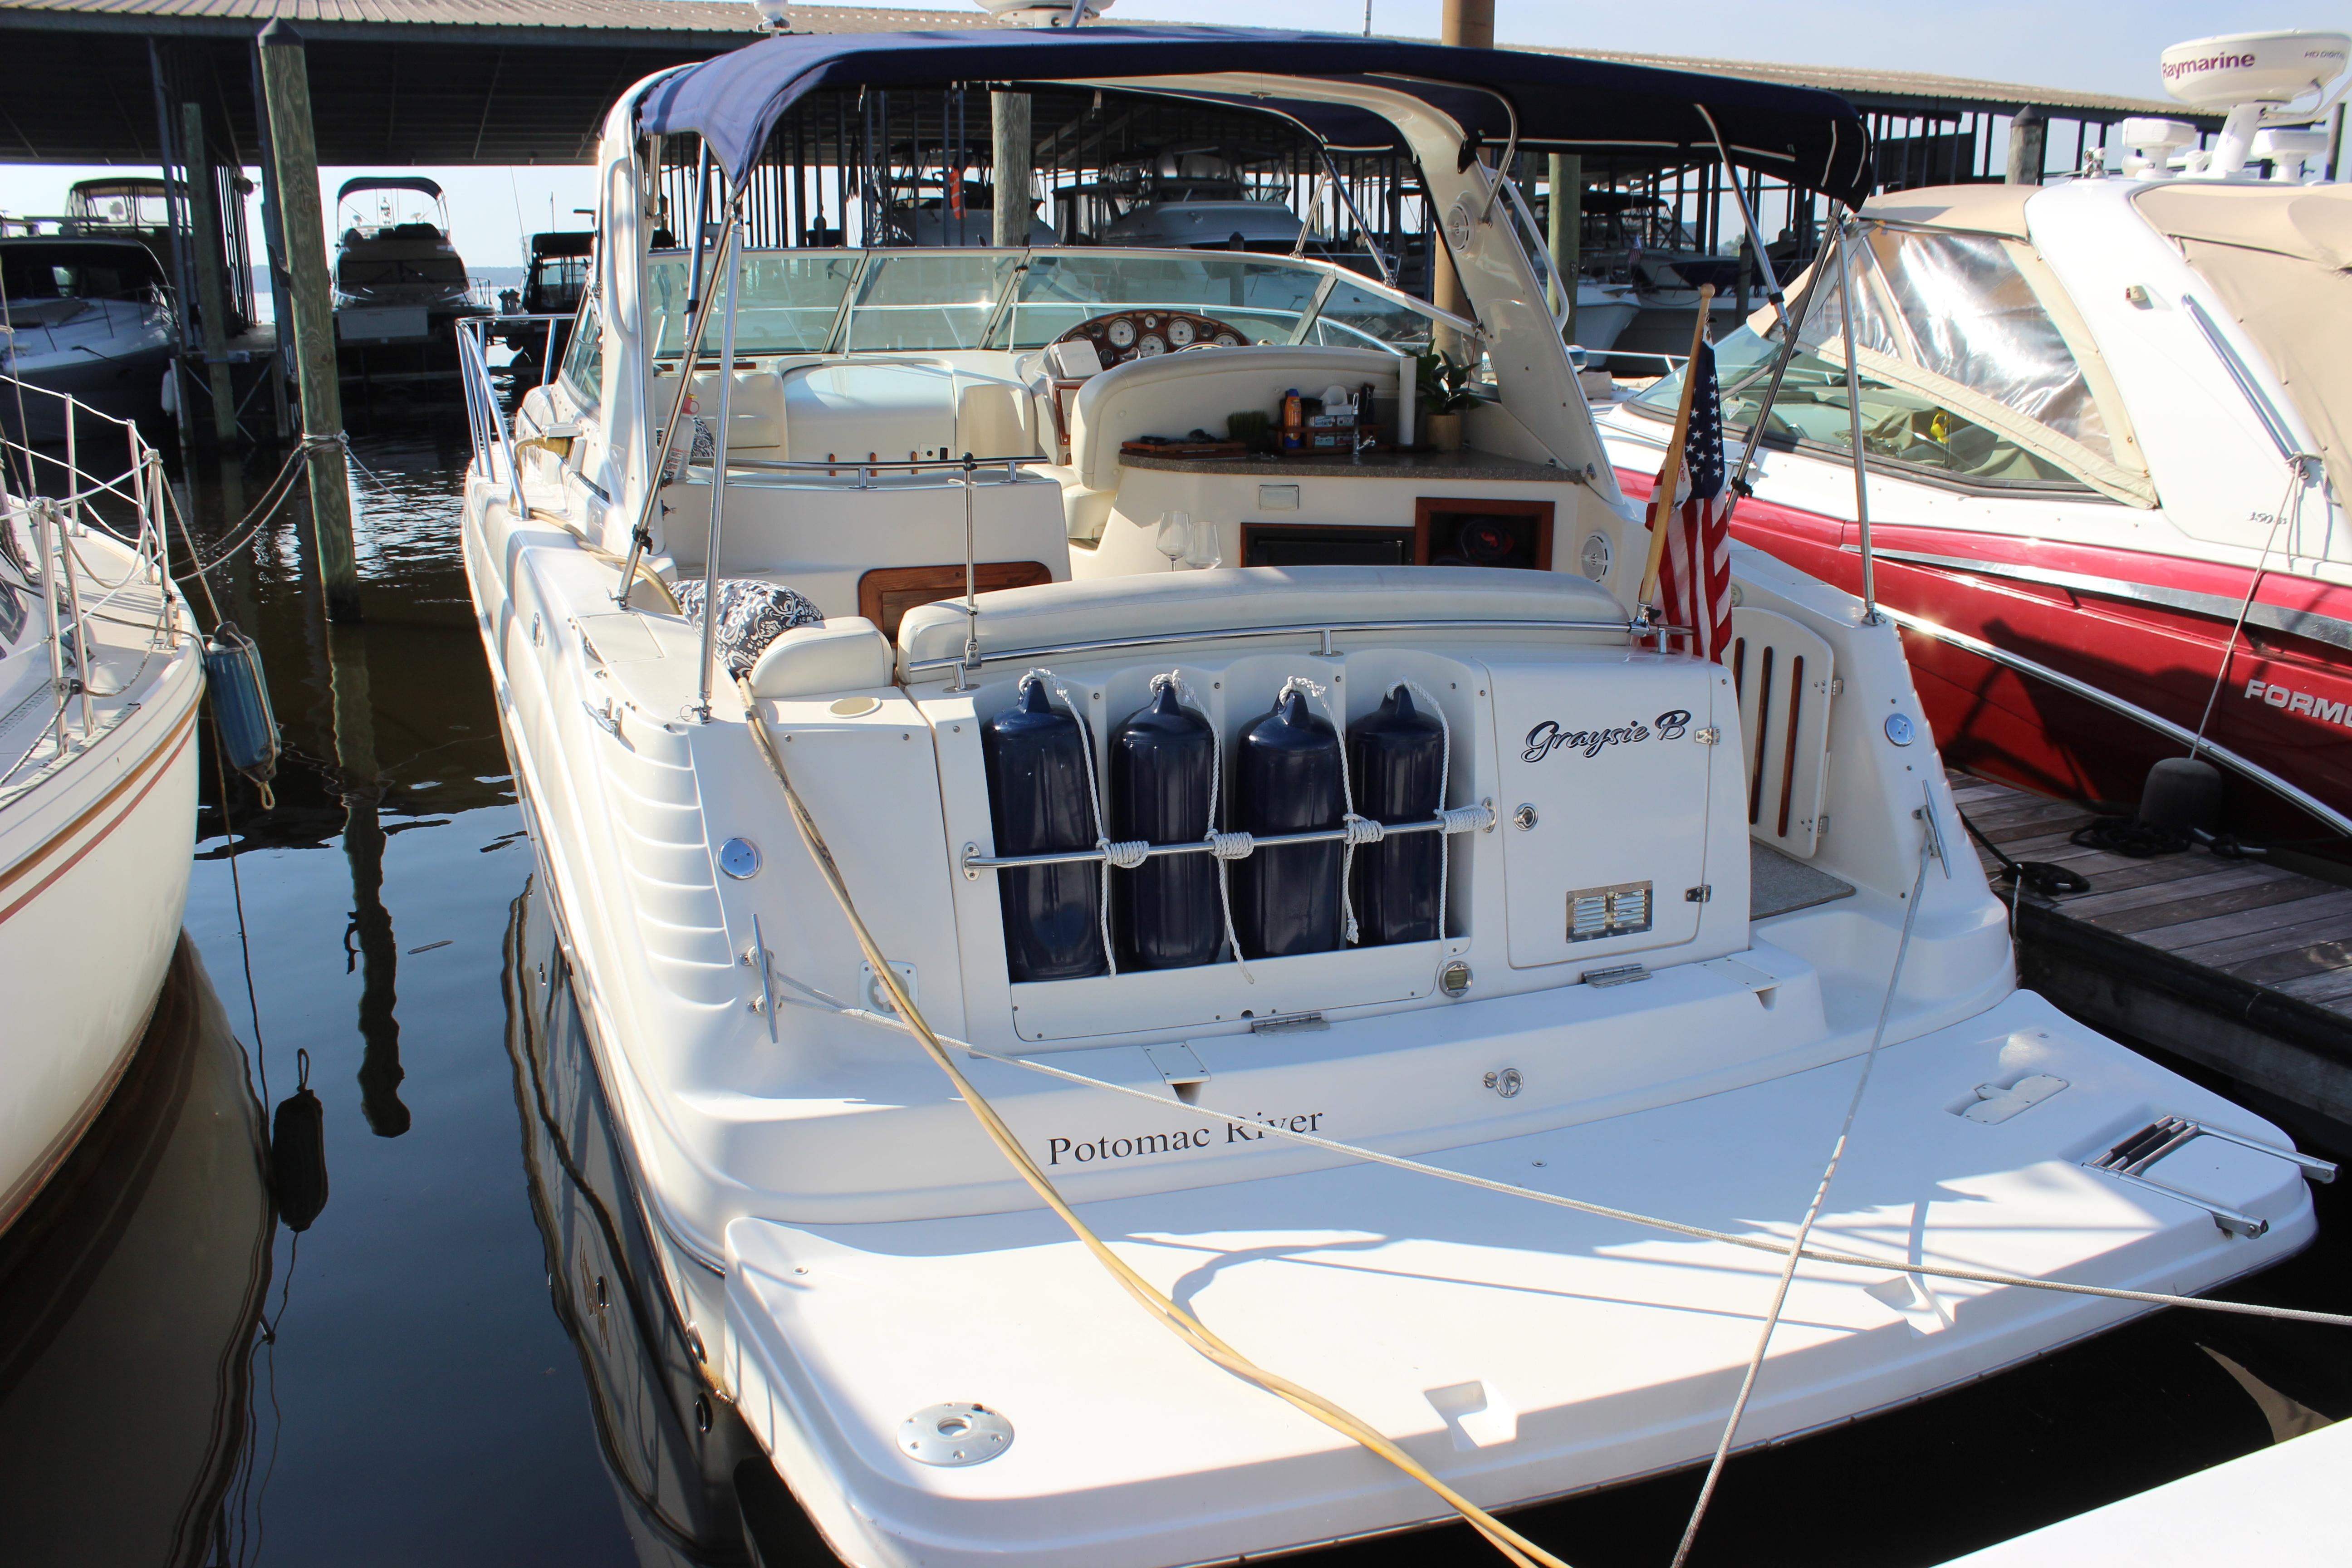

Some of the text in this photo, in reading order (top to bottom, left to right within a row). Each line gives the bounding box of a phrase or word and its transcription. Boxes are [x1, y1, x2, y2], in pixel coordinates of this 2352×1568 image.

[2162, 52, 2255, 79] Raymarine
[1521, 709, 1692, 763] Graysie B
[1047, 1128, 1210, 1166] Potomac
